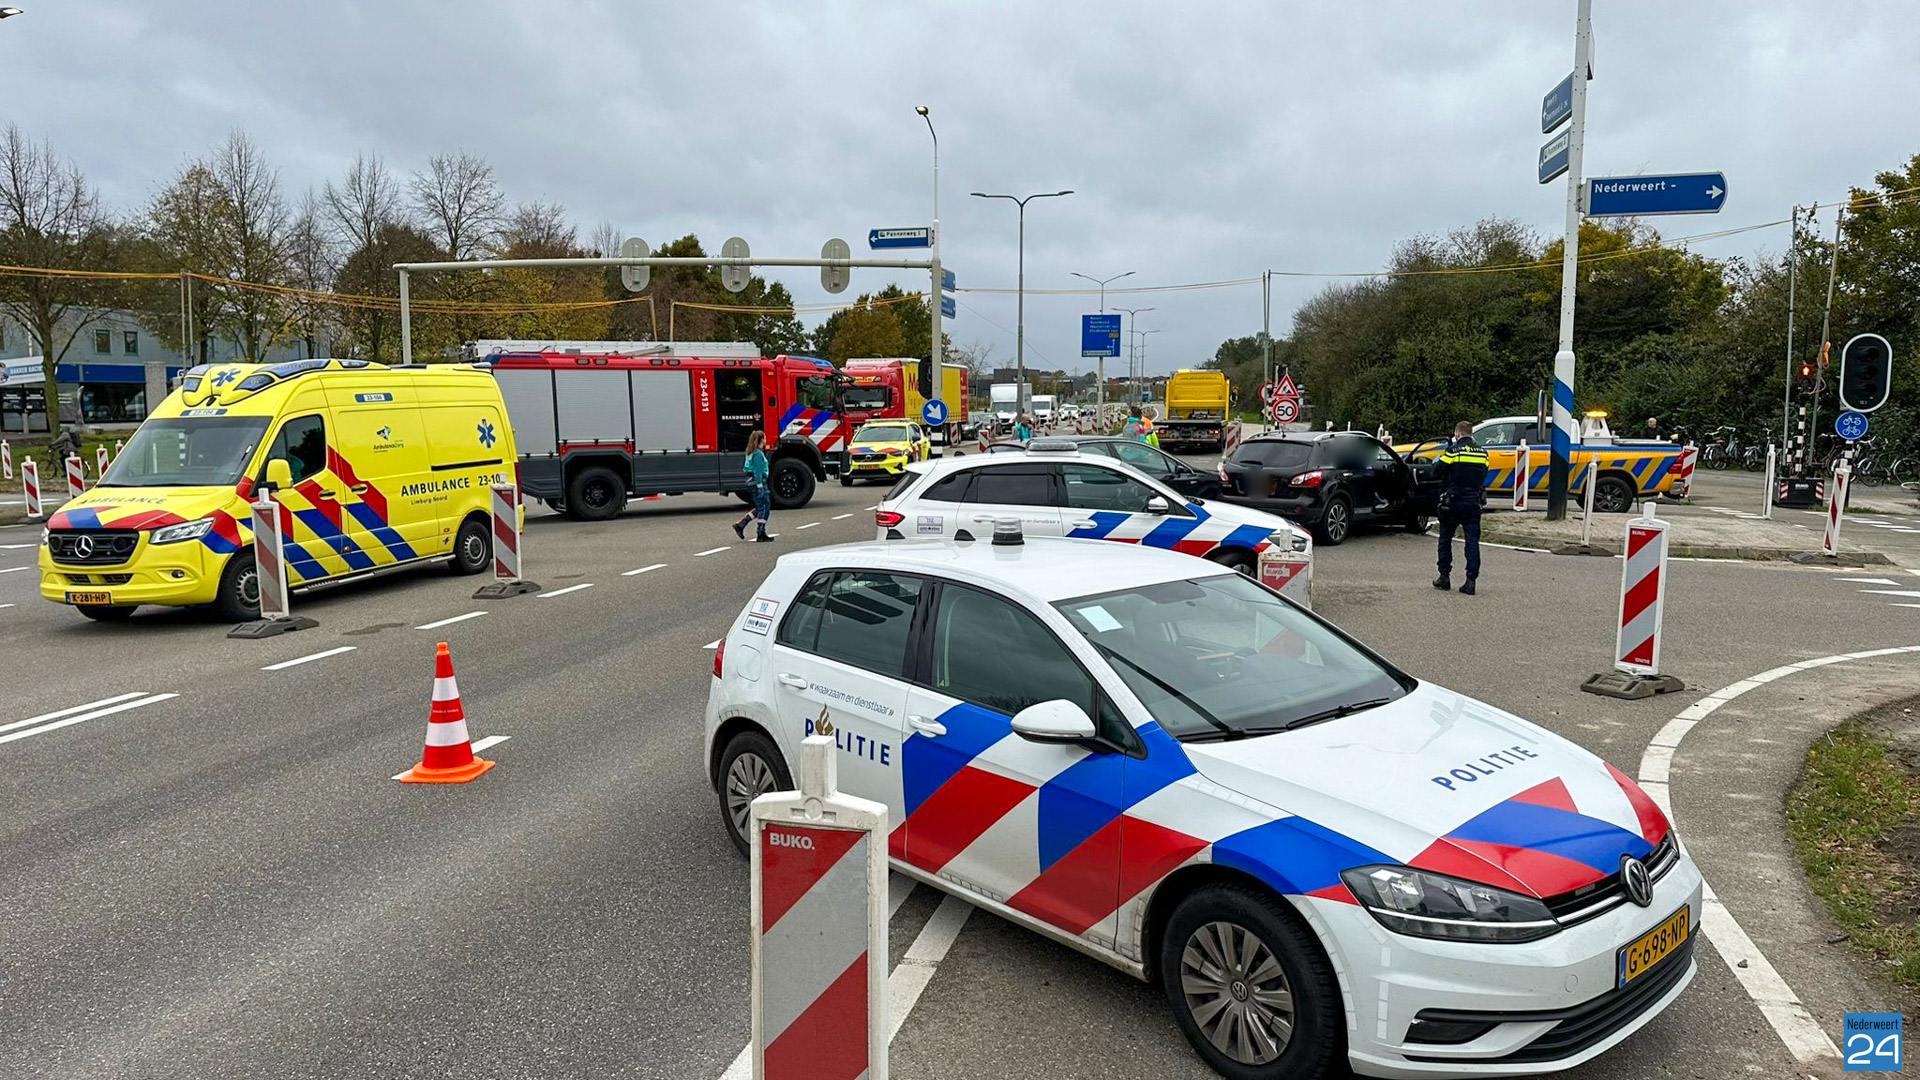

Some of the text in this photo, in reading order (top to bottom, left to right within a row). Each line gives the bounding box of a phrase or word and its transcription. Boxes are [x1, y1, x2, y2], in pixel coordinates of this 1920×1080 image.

[1594, 180, 1666, 194] Nederweert
[700, 378, 710, 412] 23-4131
[1277, 405, 1295, 417] 50
[401, 473, 507, 496] AMBULANCE 23-10
[814, 684, 846, 700] waakzaam
[845, 694, 855, 704] en
[854, 696, 889, 715] dienstbaar
[1430, 746, 1539, 791] POLITIE
[769, 832, 816, 850] BUKO.
[1629, 914, 1686, 974] G-698-NP
